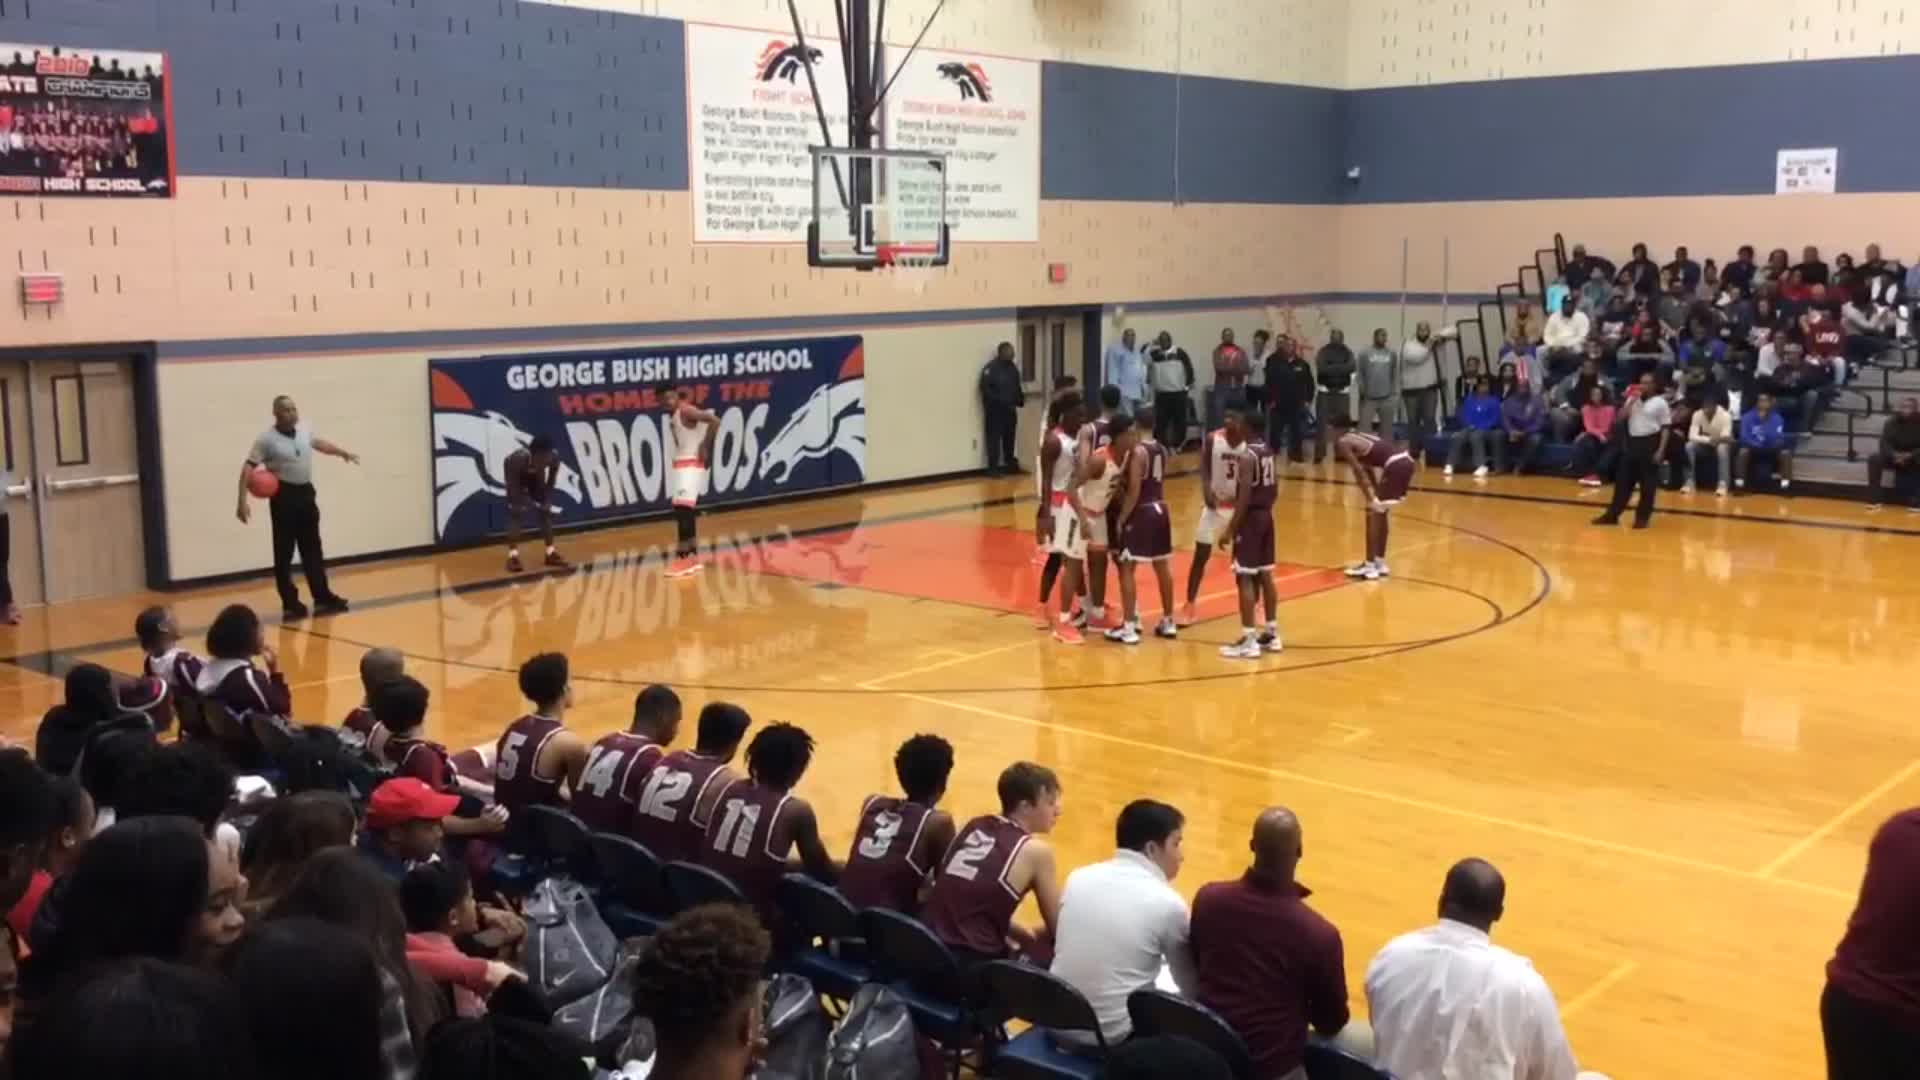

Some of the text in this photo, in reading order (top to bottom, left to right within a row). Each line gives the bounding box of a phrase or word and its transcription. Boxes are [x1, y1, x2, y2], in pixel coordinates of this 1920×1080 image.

[790, 92, 816, 105] SON
[44, 177, 81, 191] HIGH
[85, 178, 147, 192] SCHOOL
[506, 348, 813, 391] GEORGE BUSH HIGH SCHOOL
[559, 388, 660, 416] HOME
[719, 379, 773, 402] THE
[565, 402, 770, 509] BROOS
[1152, 453, 1163, 482] 4
[1225, 462, 1236, 480] 3
[1261, 455, 1276, 487] 21
[499, 731, 528, 782] 5
[576, 745, 625, 798] 14
[639, 765, 694, 823] 12
[713, 799, 762, 858] 11
[858, 808, 904, 860] 3
[945, 829, 996, 881] 2
